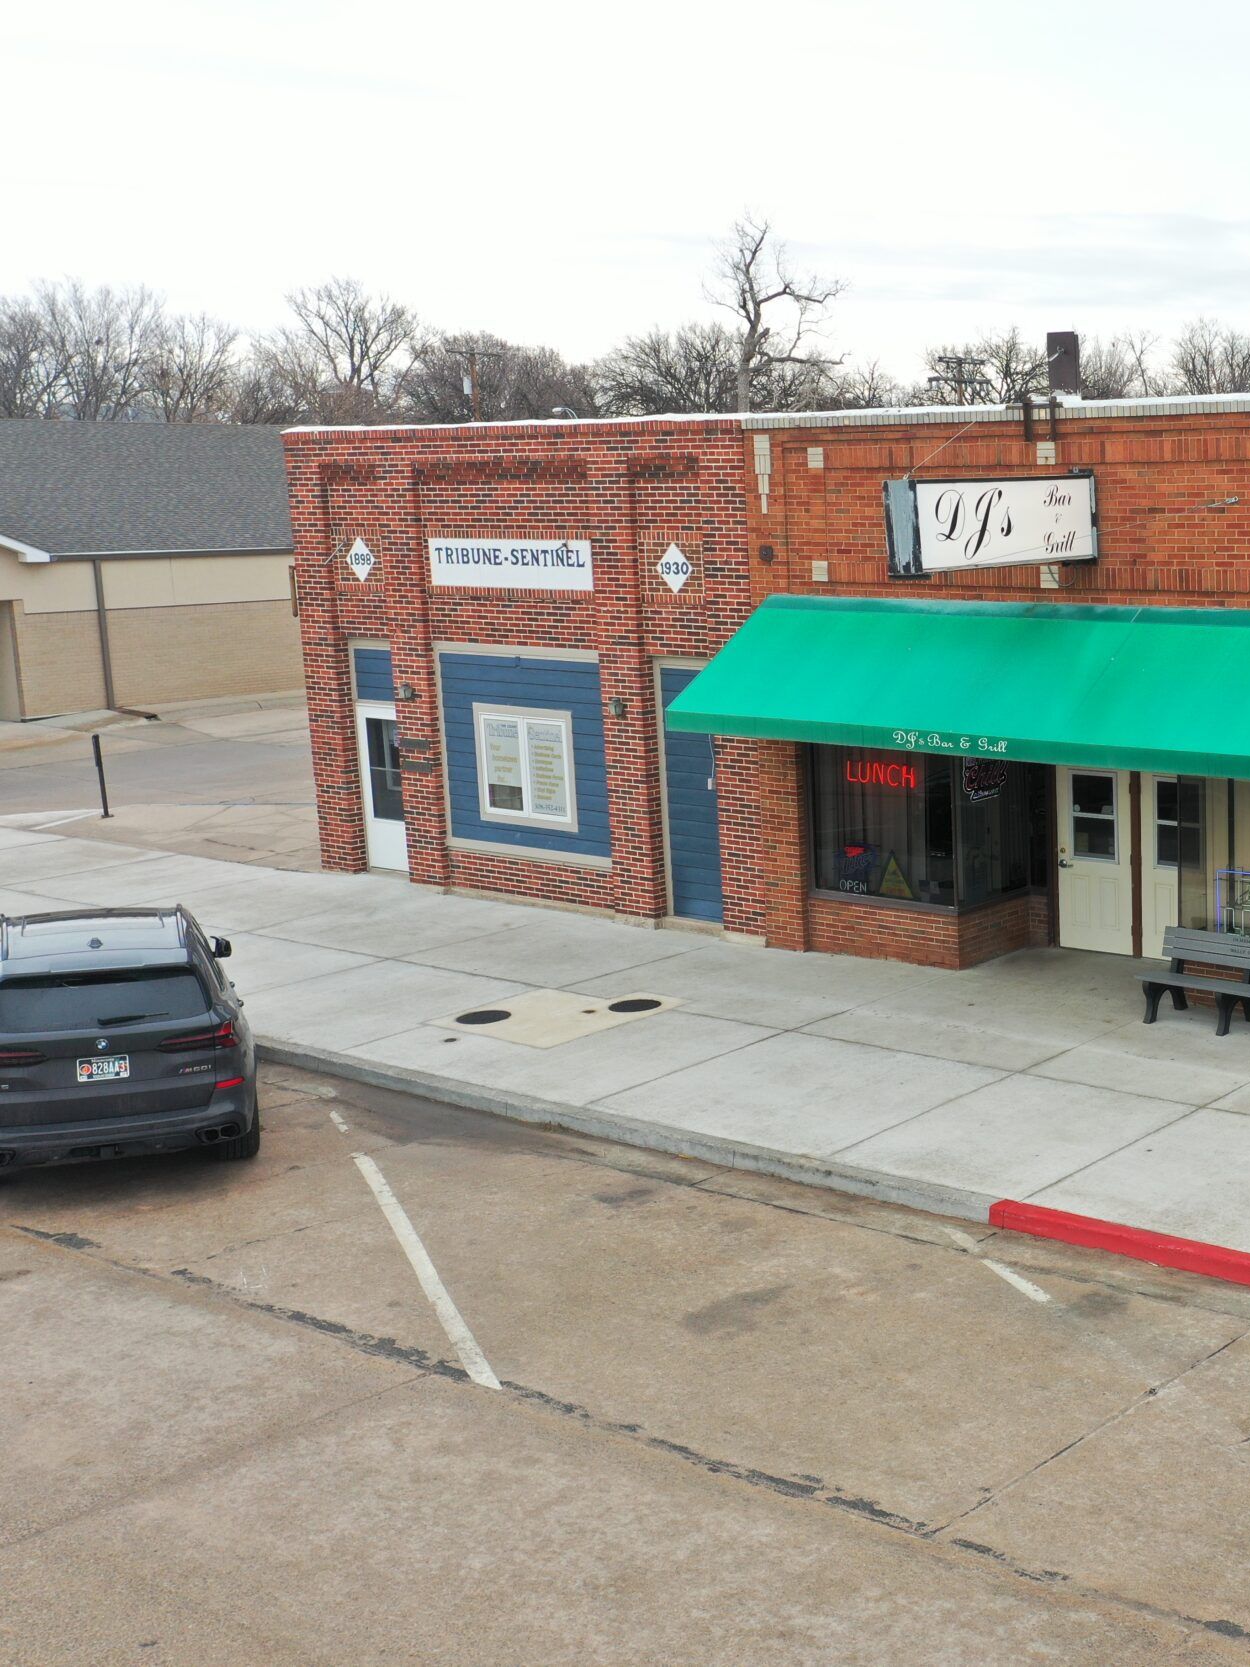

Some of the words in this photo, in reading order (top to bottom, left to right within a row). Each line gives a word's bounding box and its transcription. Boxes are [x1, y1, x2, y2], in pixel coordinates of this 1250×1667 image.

[1043, 484, 1072, 507] Bar
[935, 487, 1014, 560] DJ's
[1043, 530, 1076, 554] Grill
[349, 552, 372, 566] 1898
[434, 546, 586, 568] TRIBUNE-SENTINEL
[660, 561, 690, 576] 1930
[892, 730, 925, 750] DJ's
[927, 733, 954, 748] Bar
[960, 737, 971, 749] &
[978, 737, 1008, 753] Grill
[846, 760, 917, 789] LUNCH
[839, 879, 867, 894] OPEN
